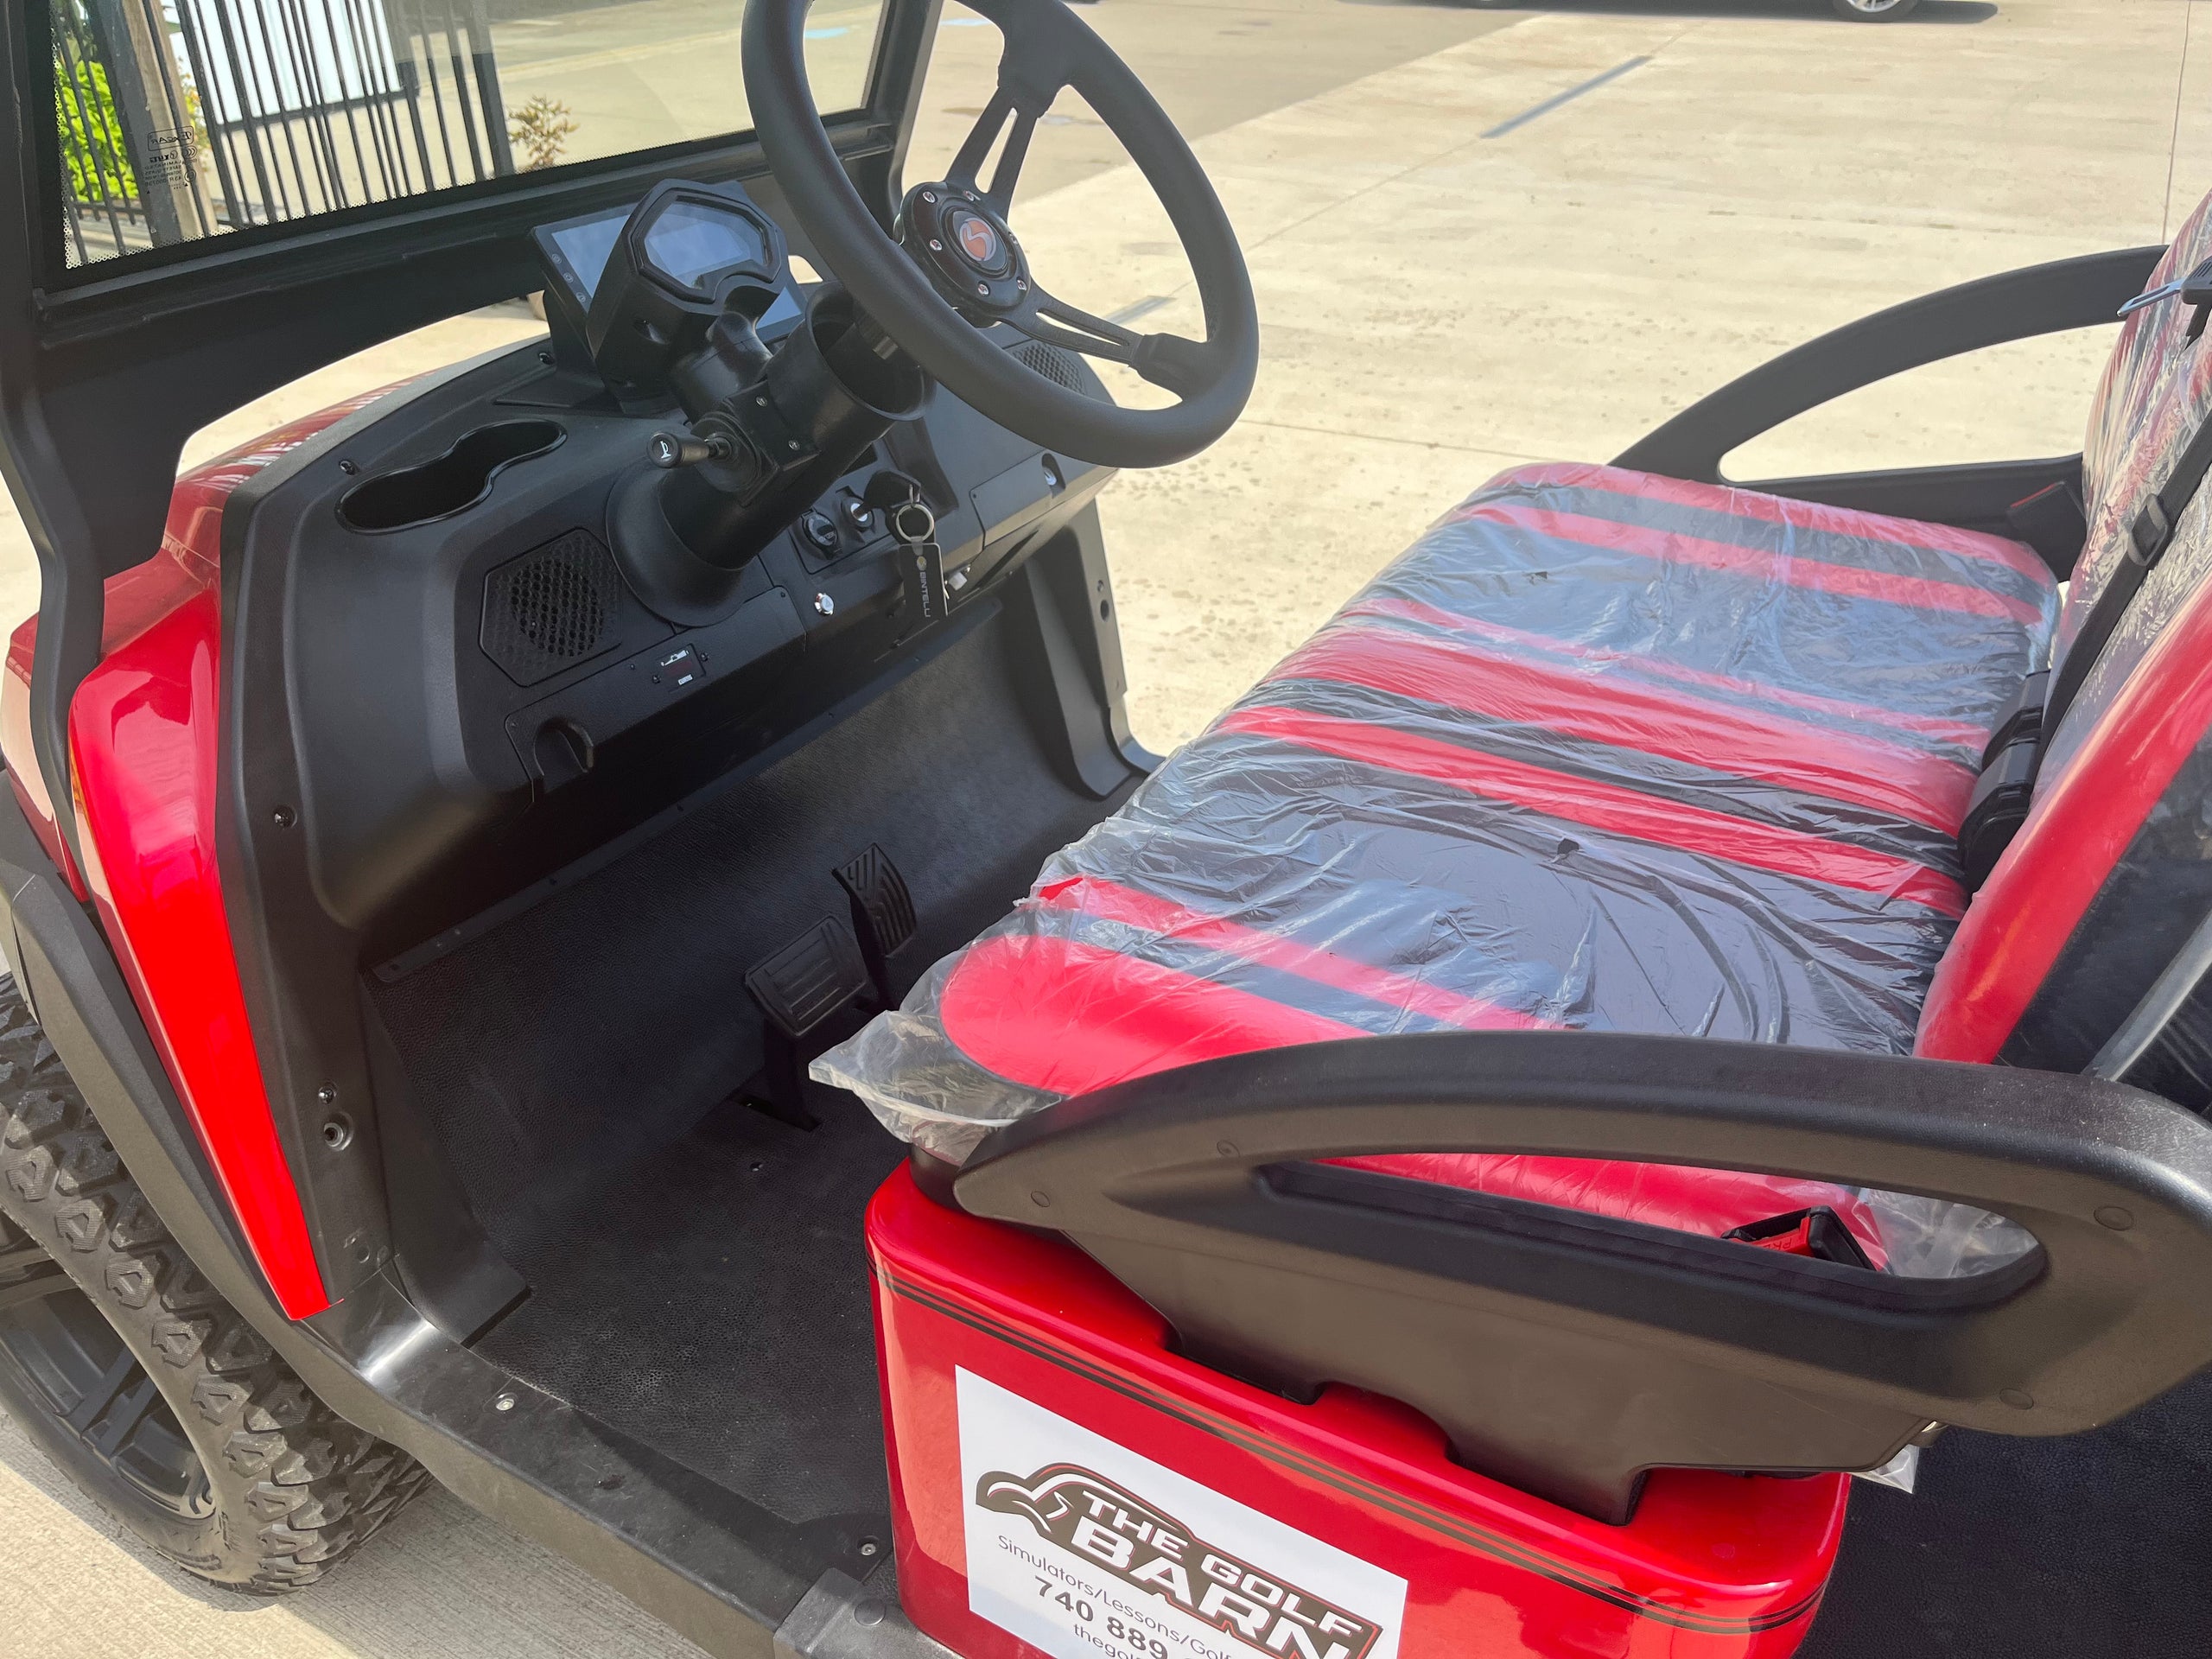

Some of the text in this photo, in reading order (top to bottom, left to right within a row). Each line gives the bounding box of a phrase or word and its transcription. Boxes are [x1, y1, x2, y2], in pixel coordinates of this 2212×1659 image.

[998, 1535, 1230, 1659] Simulators/Lessons/Go
[1034, 1575, 1168, 1659] 740 889
[1071, 1515, 1351, 1659] BARN
[1083, 1490, 1363, 1636] THE GOLF
